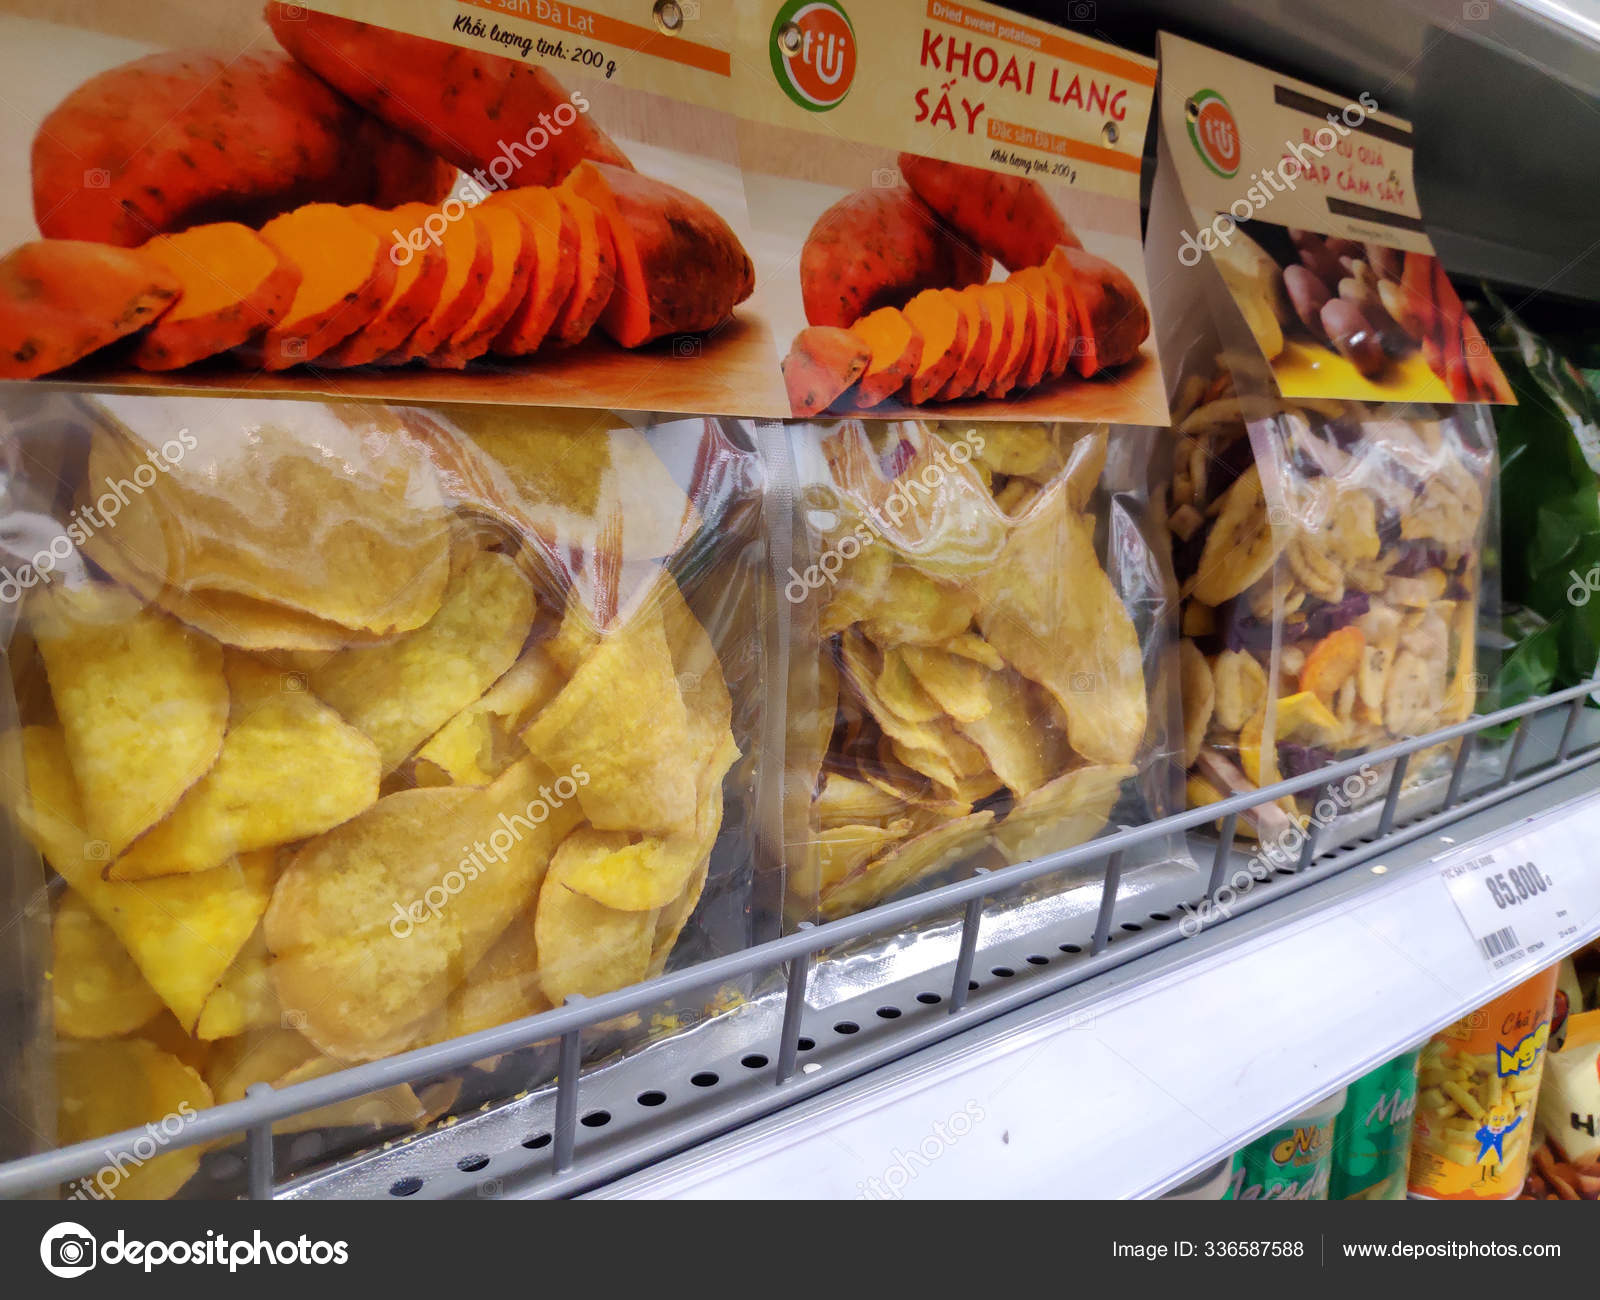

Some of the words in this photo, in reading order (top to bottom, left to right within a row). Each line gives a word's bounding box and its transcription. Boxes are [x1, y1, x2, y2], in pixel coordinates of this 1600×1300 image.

[453, 14, 487, 38] Khối
[490, 24, 533, 57] lượng
[571, 48, 604, 68] 200
[606, 61, 617, 78] g
[568, 7, 596, 36] Lạt
[932, 1, 962, 23] Dried
[964, 14, 996, 34] sweet
[998, 24, 1042, 49] potatoes
[920, 28, 1036, 95] KHOAI
[1048, 68, 1128, 122] LANG
[914, 79, 985, 135] SẤY
